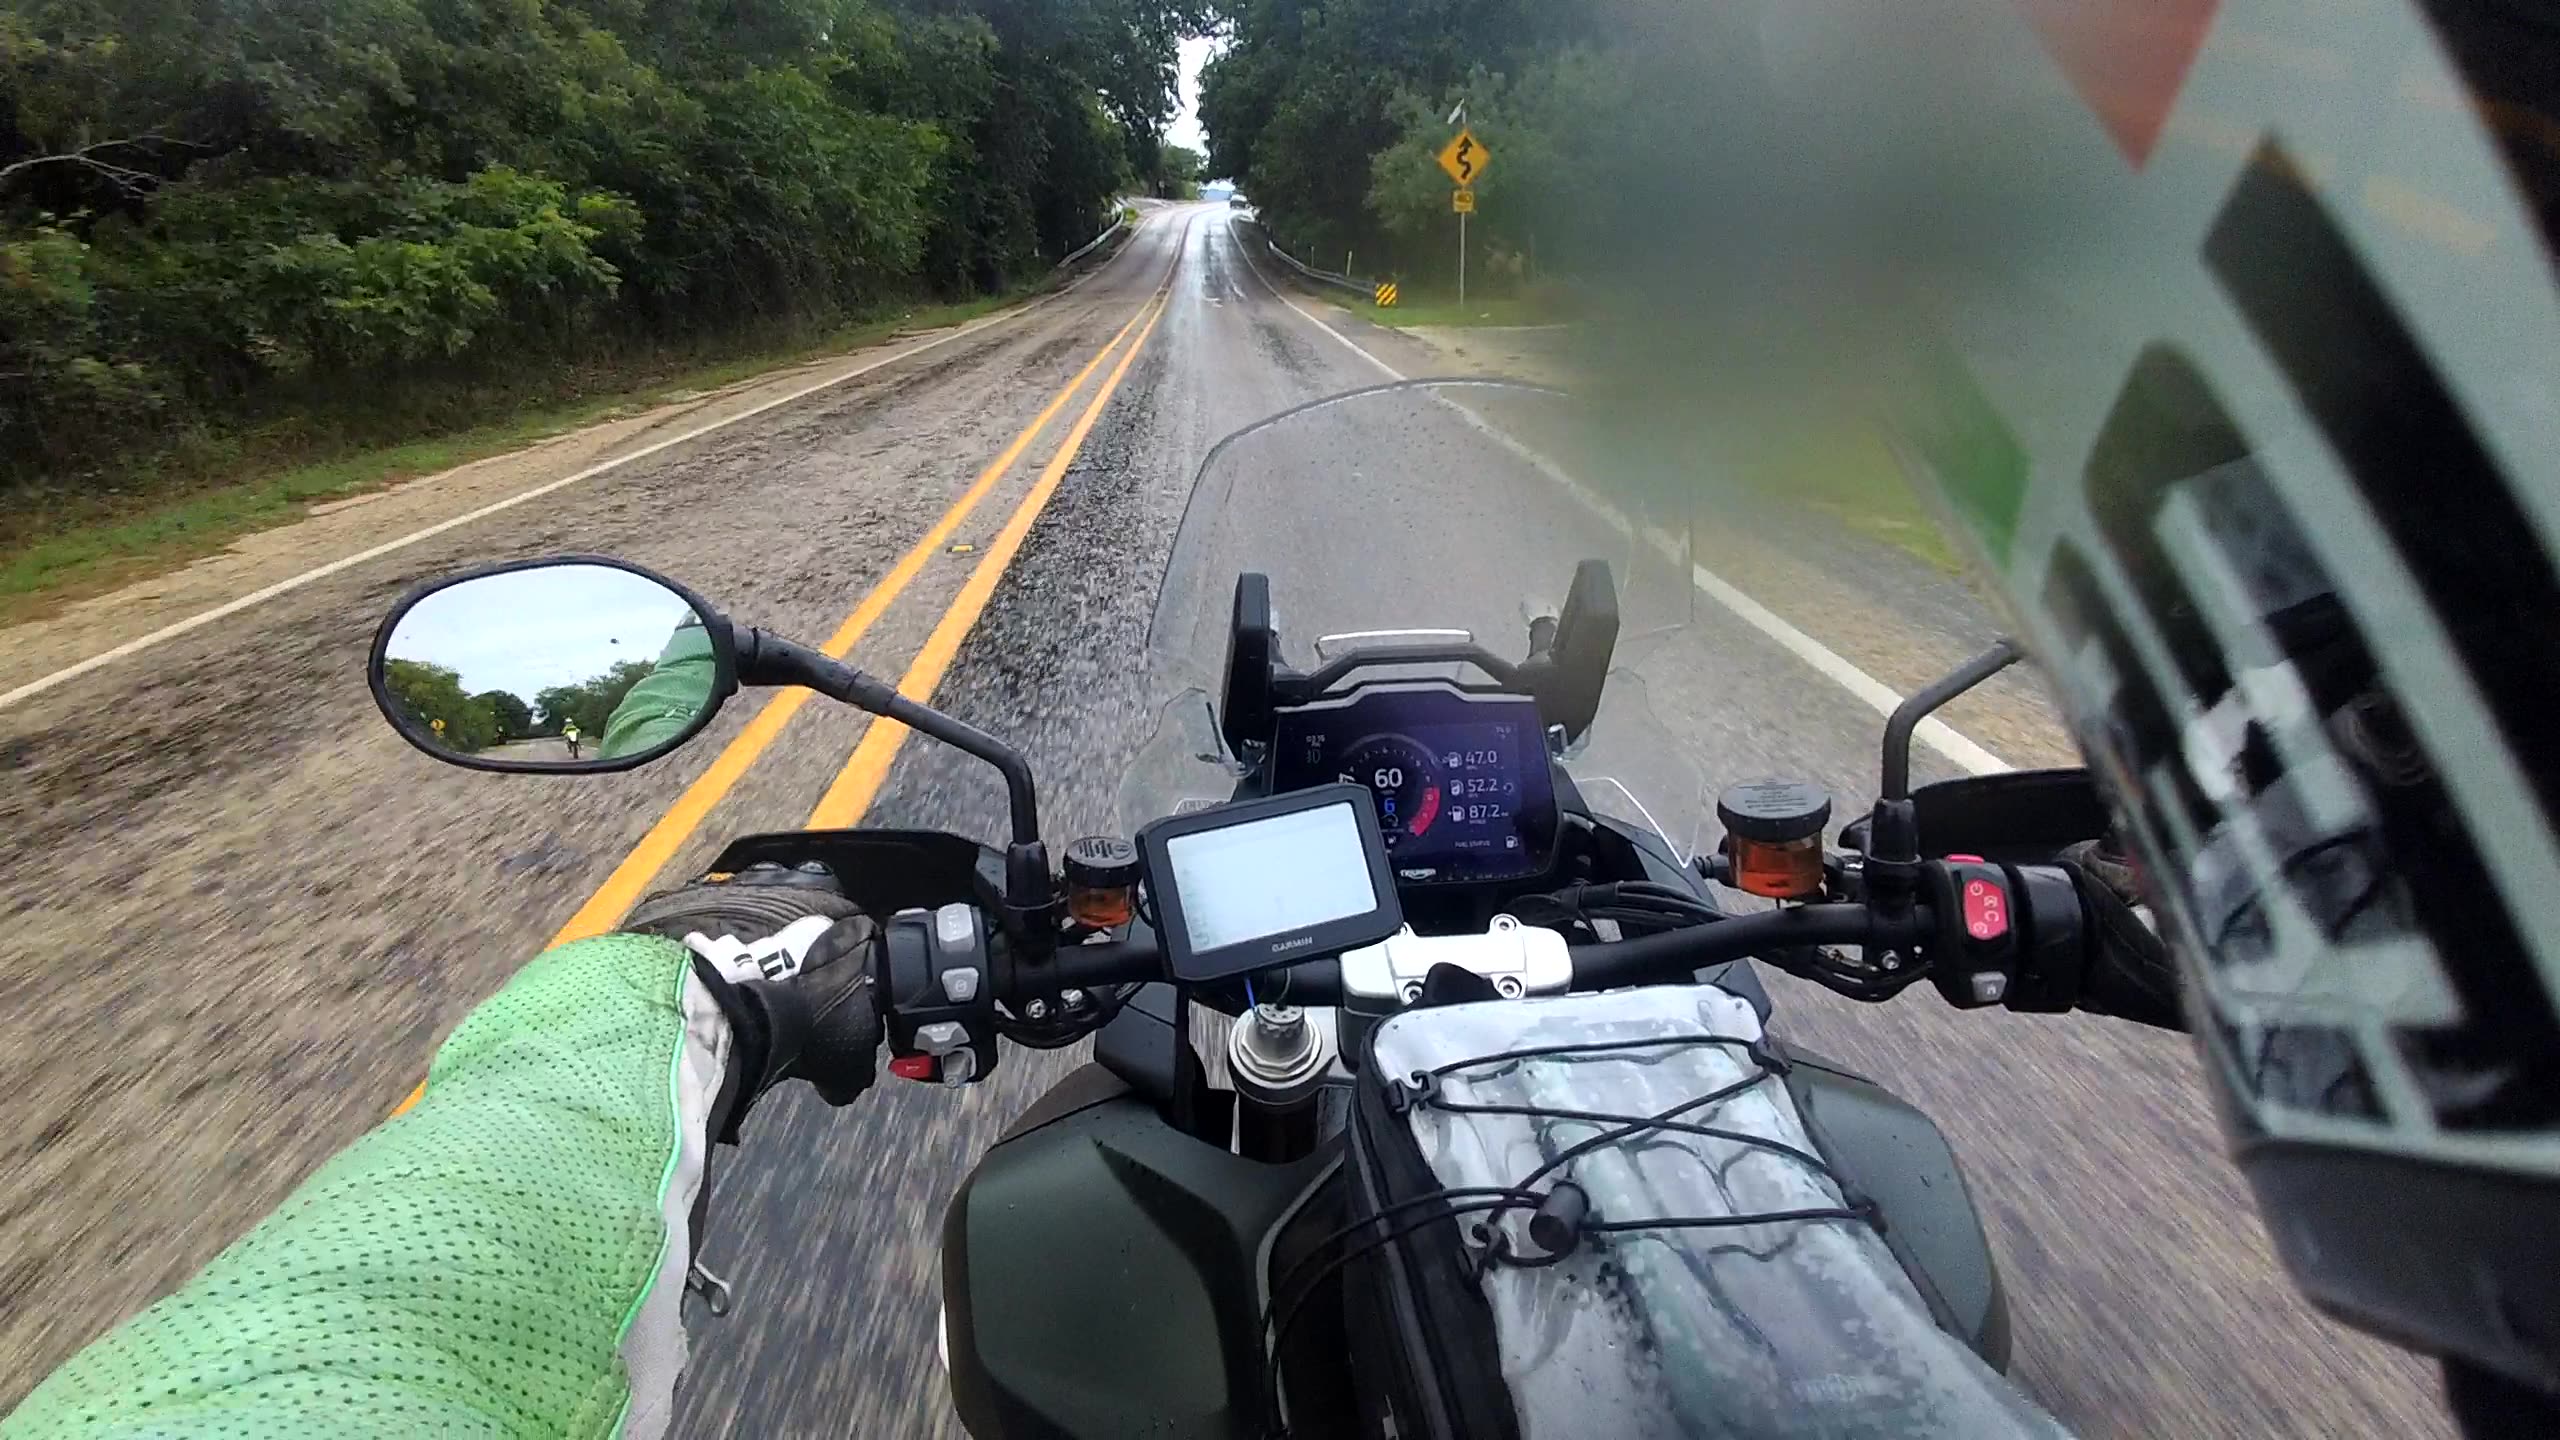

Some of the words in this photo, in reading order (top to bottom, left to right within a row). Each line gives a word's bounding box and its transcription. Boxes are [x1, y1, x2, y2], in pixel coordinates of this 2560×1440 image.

[1466, 750, 1498, 765] 47.0
[1375, 768, 1403, 788] 60
[1468, 778, 1498, 793] 52.2
[1384, 797, 1395, 813] 6
[1469, 805, 1500, 819] 87.2
[1271, 936, 1313, 953] GARMIN
